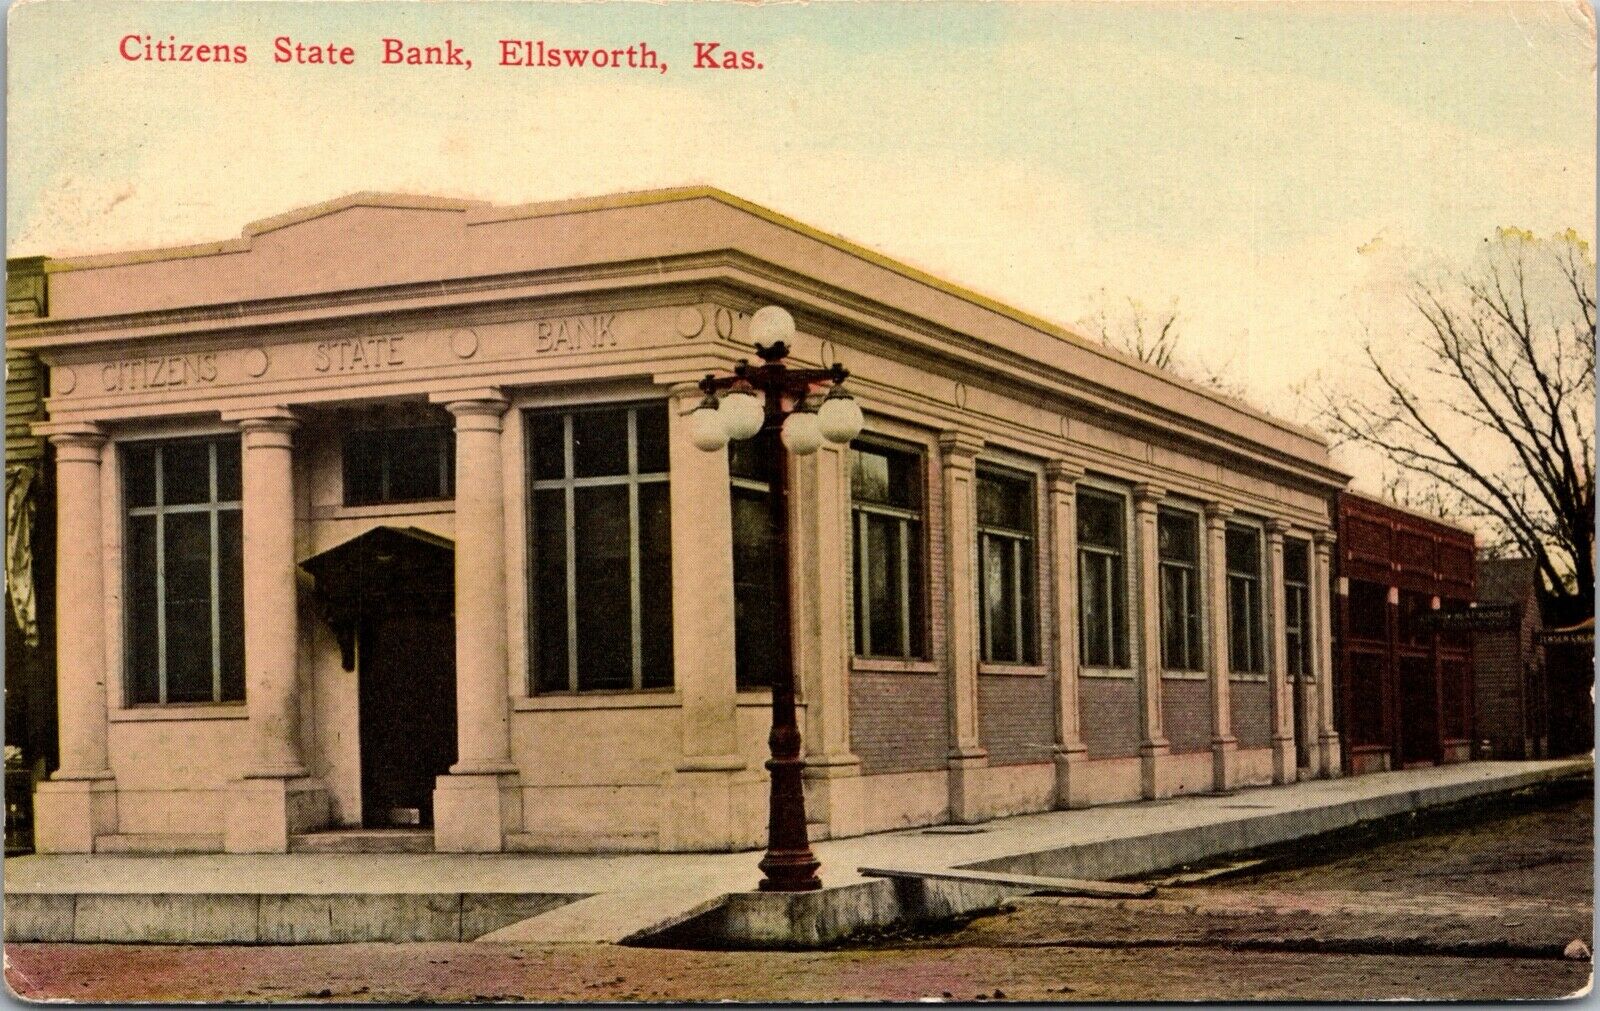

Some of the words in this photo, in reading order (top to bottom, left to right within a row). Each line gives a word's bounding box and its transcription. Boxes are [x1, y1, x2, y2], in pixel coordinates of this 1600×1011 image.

[101, 352, 218, 392] CITIZENS
[314, 337, 405, 373] STATE
[536, 312, 617, 352] BANK
